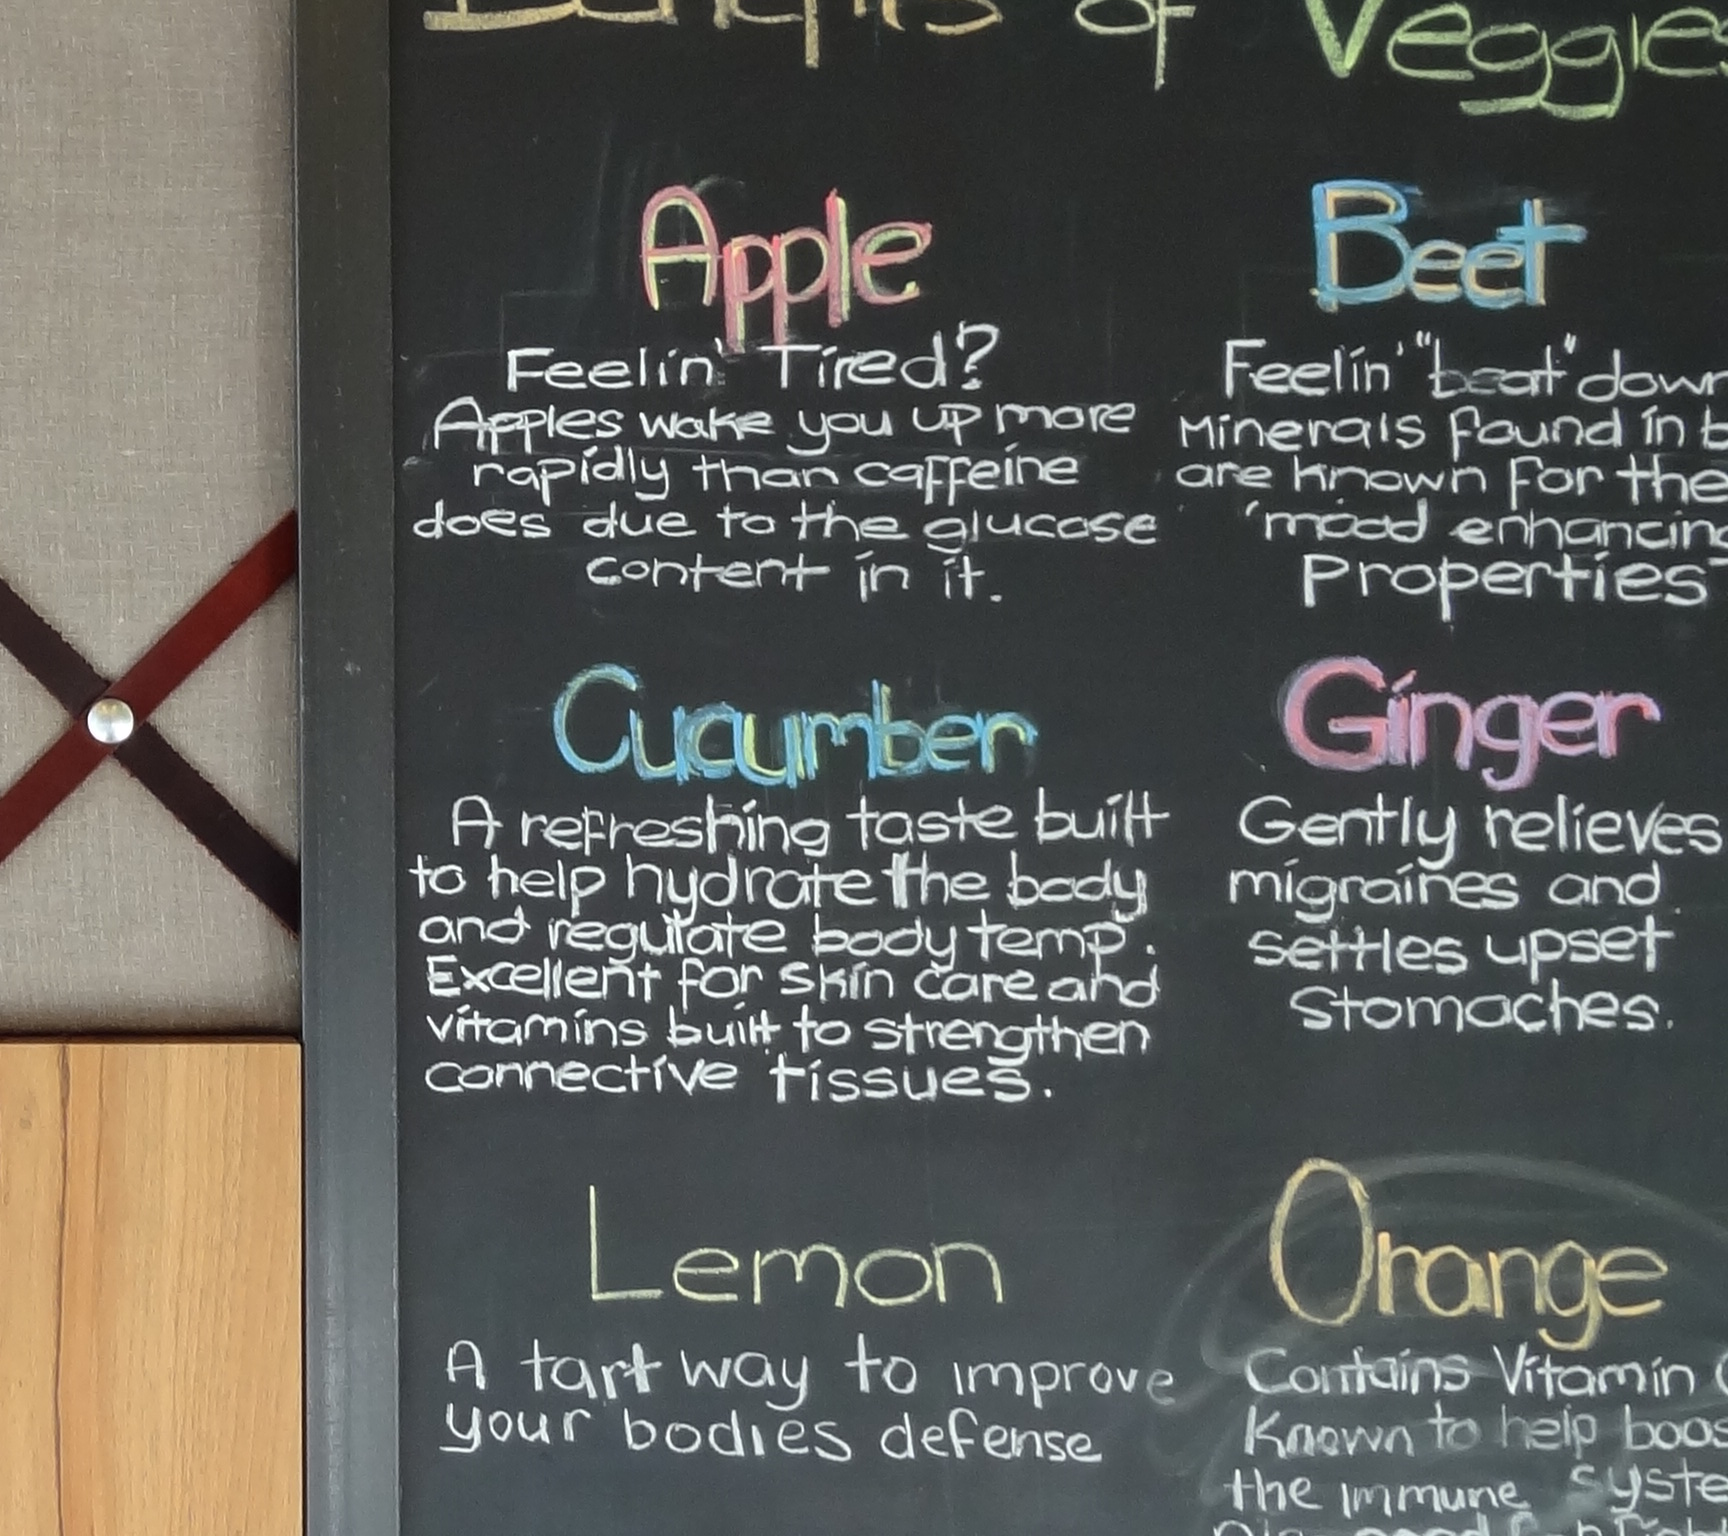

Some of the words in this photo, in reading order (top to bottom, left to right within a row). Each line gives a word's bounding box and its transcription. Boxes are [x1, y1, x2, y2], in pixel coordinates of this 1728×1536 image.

[641, 186, 932, 354] Apple
[1309, 179, 1589, 312] Beet
[761, 321, 999, 390] Tired?
[473, 445, 670, 503] rapidly
[692, 455, 840, 491] than
[853, 444, 1080, 505] caffeine
[1175, 462, 1273, 489] are
[1293, 455, 1487, 495] known
[1509, 455, 1604, 511] for
[587, 552, 830, 592] content
[856, 550, 910, 601] in
[943, 554, 1002, 602] it.
[1304, 551, 1709, 622] Properties
[553, 663, 1038, 788] Cucumber
[1278, 655, 1662, 791] Ginger
[450, 795, 503, 849] A
[521, 793, 830, 857] refreshing
[846, 794, 1018, 845] taste
[1238, 792, 1458, 871] Gently
[1485, 792, 1724, 855] relieves
[1230, 857, 1521, 924] migraines
[1549, 860, 1662, 907] and
[426, 954, 662, 1002] Excellent
[678, 959, 764, 1013] for
[779, 960, 894, 1003] skin
[915, 967, 1038, 1003] care
[1048, 957, 1161, 1008] and
[1247, 924, 1469, 974] settles
[1485, 914, 1675, 985] upset
[1289, 977, 1675, 1034] Stomaches.
[424, 1052, 738, 1096] connective
[769, 1052, 1053, 1104] tissues.
[589, 1185, 1004, 1308] Lemon
[1270, 1158, 1668, 1350] Orange
[444, 1339, 486, 1389] A
[520, 1339, 662, 1400] tart
[679, 1349, 809, 1411] way
[844, 1332, 919, 1395] to
[952, 1359, 1175, 1407] improve
[1244, 1345, 1472, 1396] Contains
[1493, 1342, 1696, 1400] Vitamin
[439, 1401, 592, 1452] your
[624, 1410, 853, 1461] bodies
[879, 1406, 1103, 1462] defense
[1244, 1404, 1416, 1459] Known
[1427, 1401, 1481, 1449] to
[1501, 1401, 1598, 1460] help
